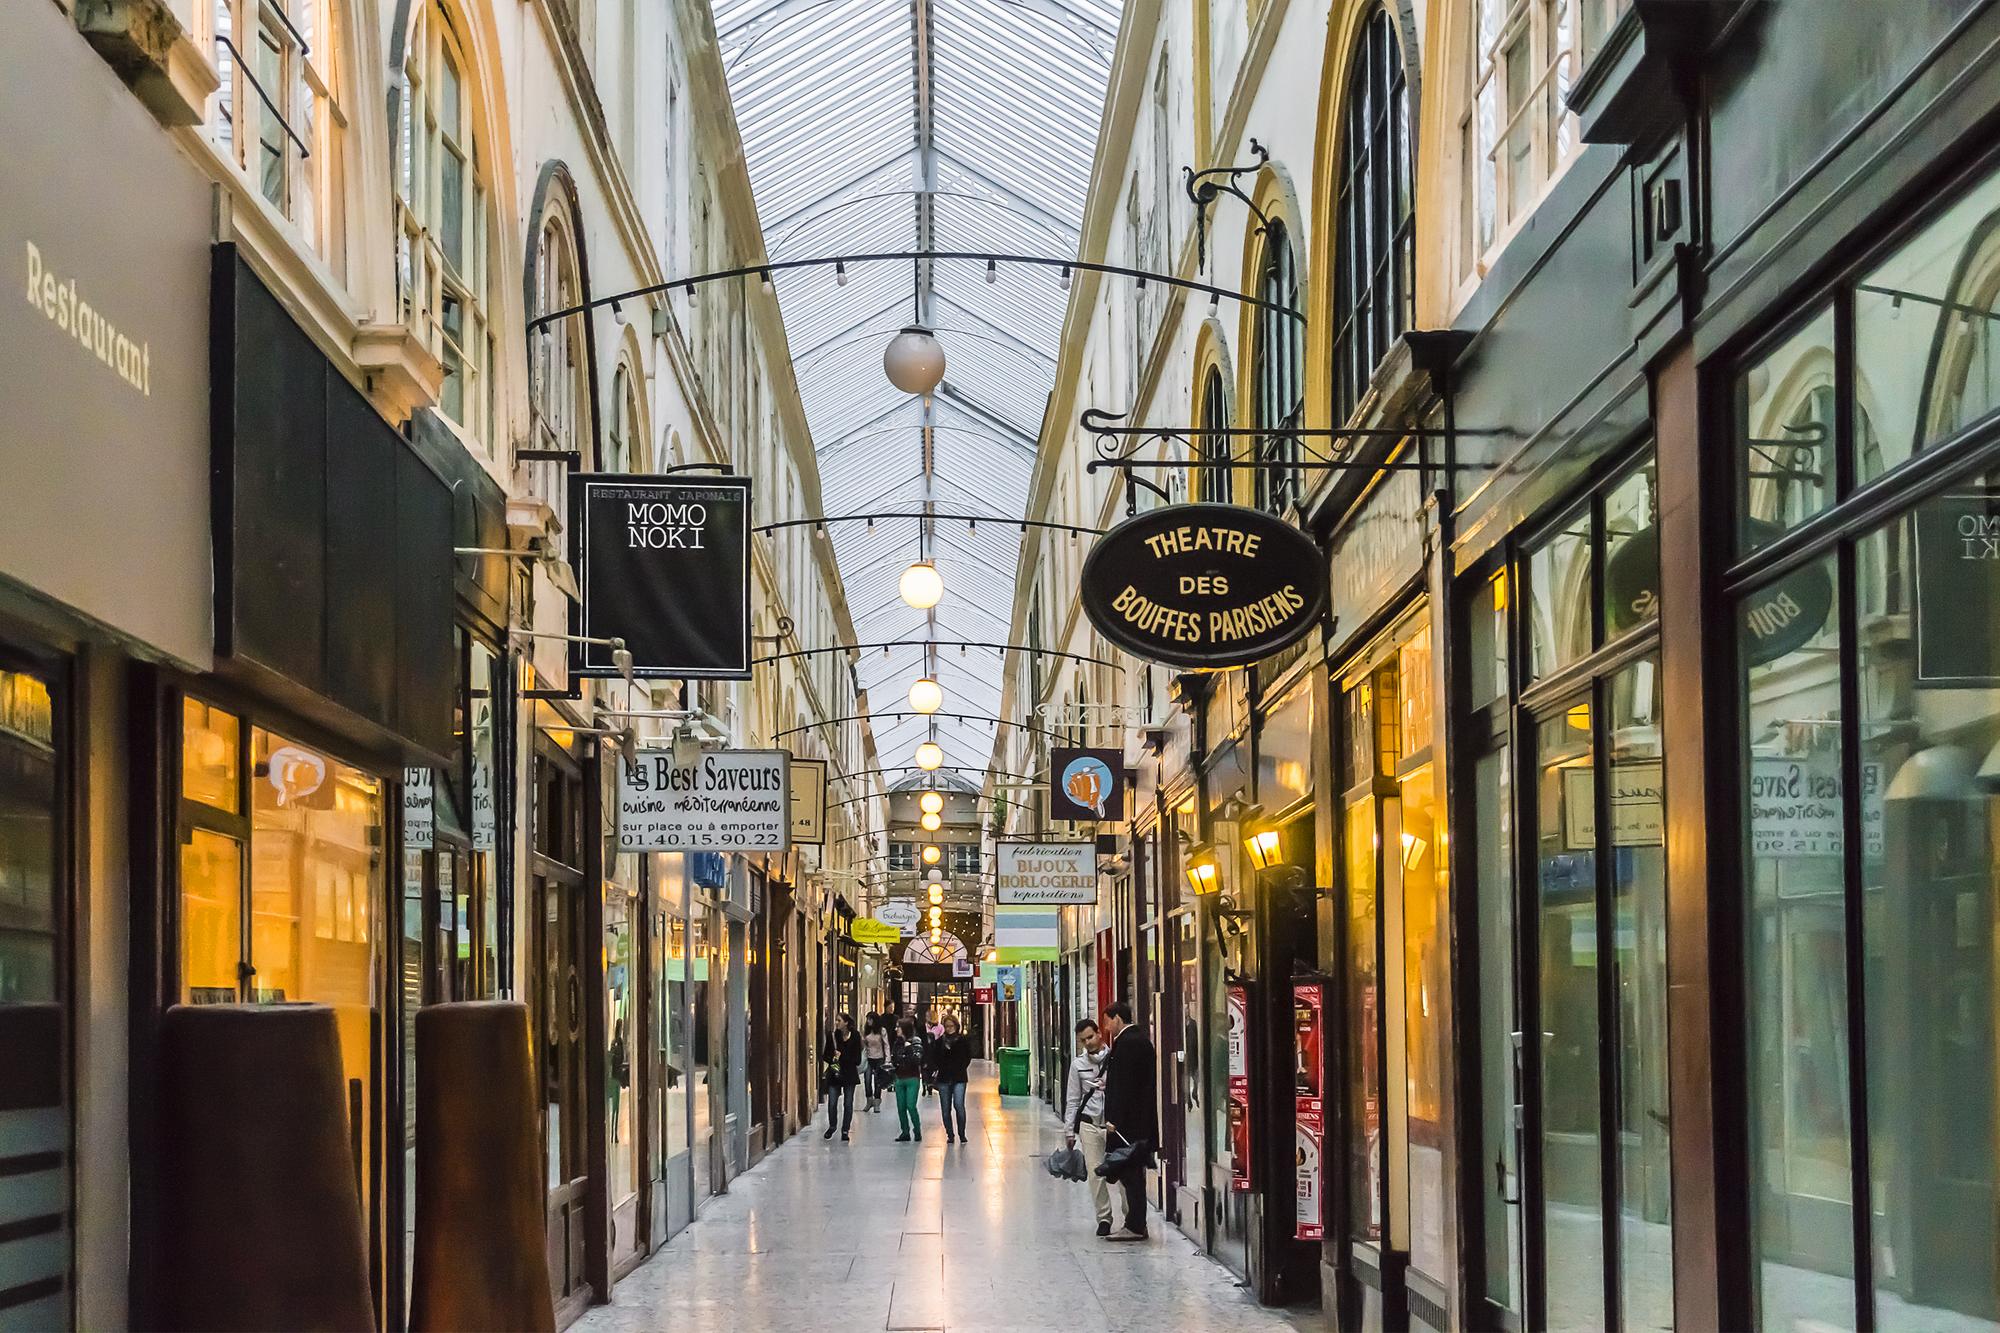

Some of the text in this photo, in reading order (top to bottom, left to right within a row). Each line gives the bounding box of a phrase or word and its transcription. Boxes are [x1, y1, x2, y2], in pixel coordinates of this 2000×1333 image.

[27, 240, 150, 396] Restaurant
[592, 488, 741, 501] RESTAURANT JAPONAIS
[627, 503, 706, 526] MOMO
[628, 526, 705, 549] NOKI
[1144, 526, 1262, 559] THEATRE
[1179, 576, 1229, 595] DES
[1111, 584, 1304, 643] BOUFFES PARISIENS
[654, 756, 699, 791] Best
[705, 755, 781, 791] Saveurs
[622, 794, 781, 814] cuisine méditerranéenne
[622, 823, 643, 832] sur
[647, 822, 682, 833] place
[688, 823, 703, 832] ou
[708, 822, 716, 832] à
[721, 822, 779, 833] emporter
[621, 833, 780, 846] 01.40.15.90.22
[1012, 846, 1082, 859] fabrication
[1017, 860, 1078, 873] BIJOUX
[999, 875, 1095, 888] HORLOGERIE
